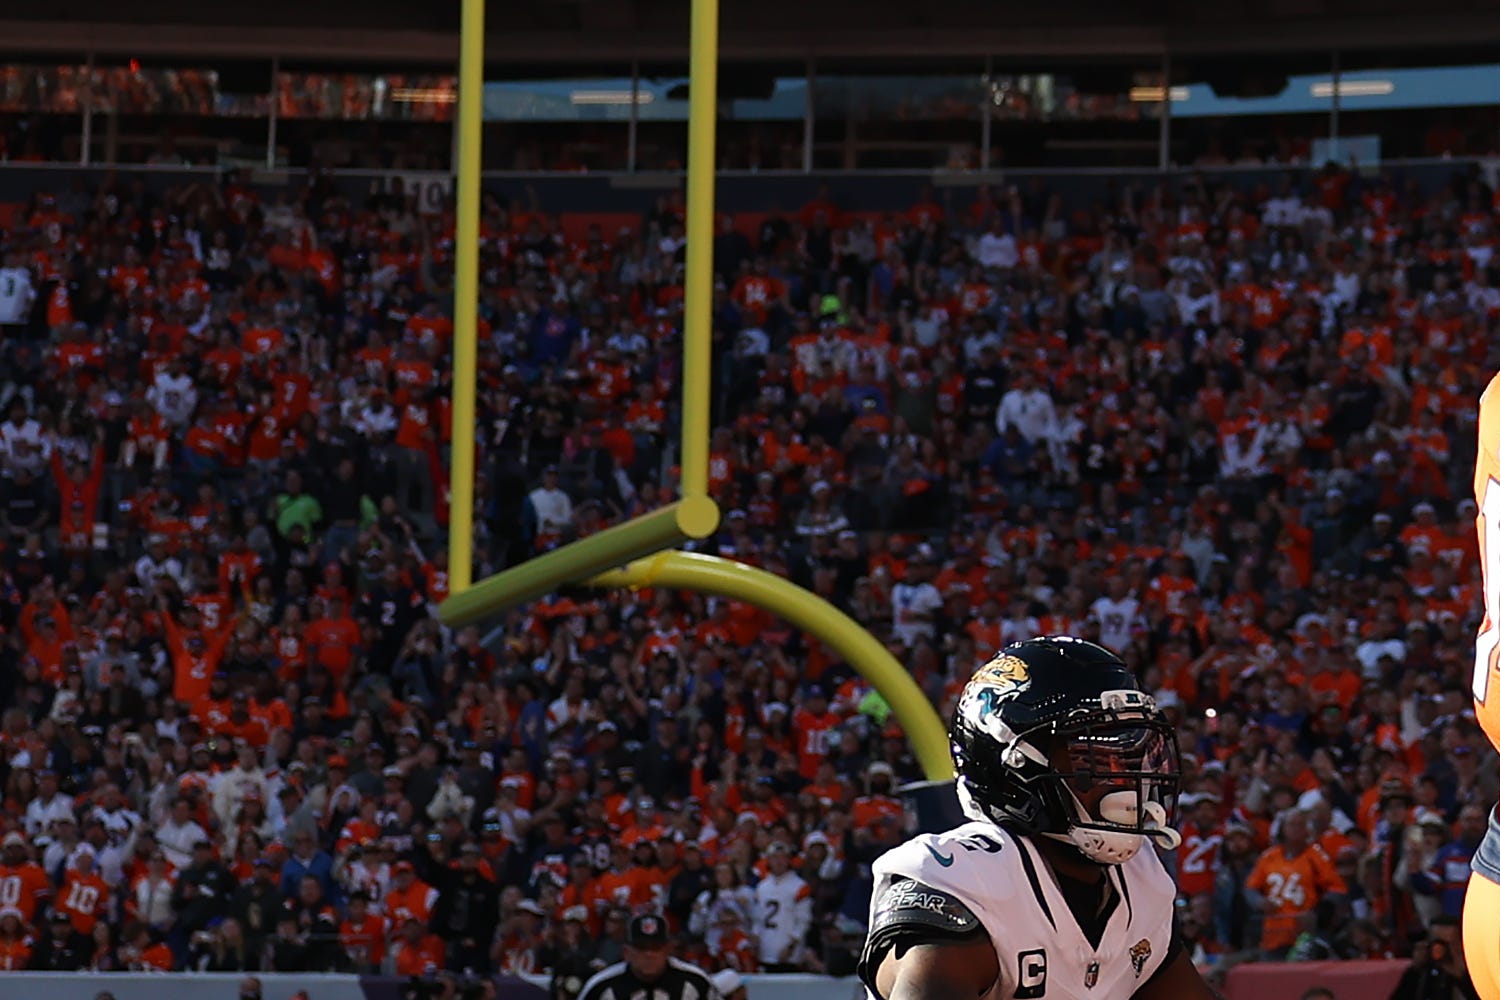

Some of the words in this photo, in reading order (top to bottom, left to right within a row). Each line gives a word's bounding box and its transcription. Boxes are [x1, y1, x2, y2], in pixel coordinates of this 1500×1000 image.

[380, 600, 397, 626] 2
[764, 900, 780, 929] 2
[1021, 953, 1046, 988] C
